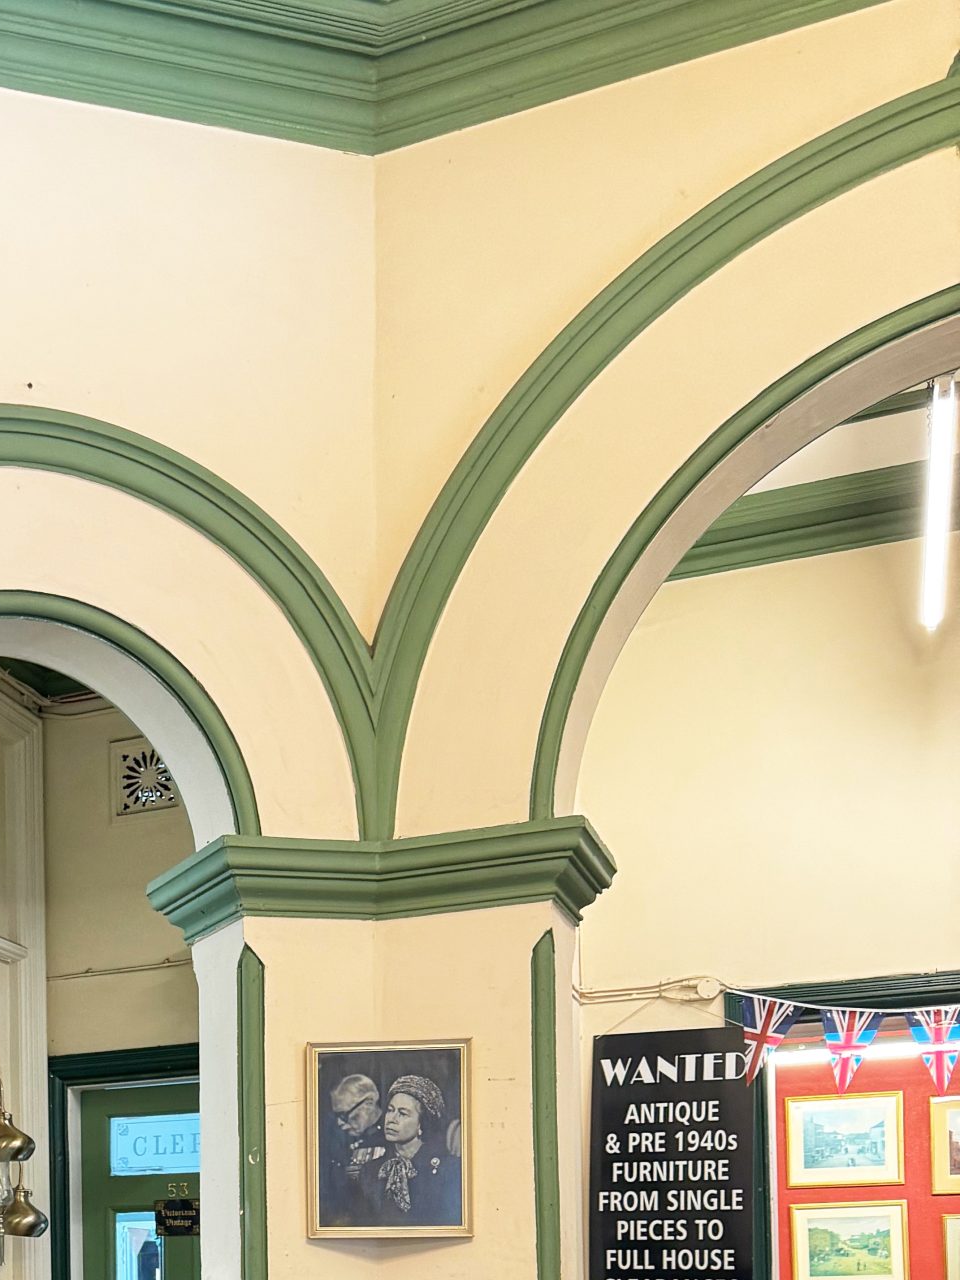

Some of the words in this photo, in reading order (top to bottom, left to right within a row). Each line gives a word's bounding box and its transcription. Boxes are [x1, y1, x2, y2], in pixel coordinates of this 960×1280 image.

[600, 1052, 746, 1086] WANTED
[625, 1101, 719, 1125] ANTIQUE
[606, 1134, 620, 1153] &
[629, 1132, 665, 1152] PRE
[675, 1130, 737, 1151] 1940s
[613, 1160, 729, 1182] FURNITURE
[168, 1183, 188, 1197] 53
[599, 1191, 658, 1211] FROM
[667, 1190, 743, 1211] SINGLE
[166, 1219, 193, 1227] Vintage
[618, 1220, 687, 1240] PIECES
[695, 1220, 723, 1240] TO
[607, 1250, 654, 1269] FULL
[663, 1249, 734, 1270] HOUSE
